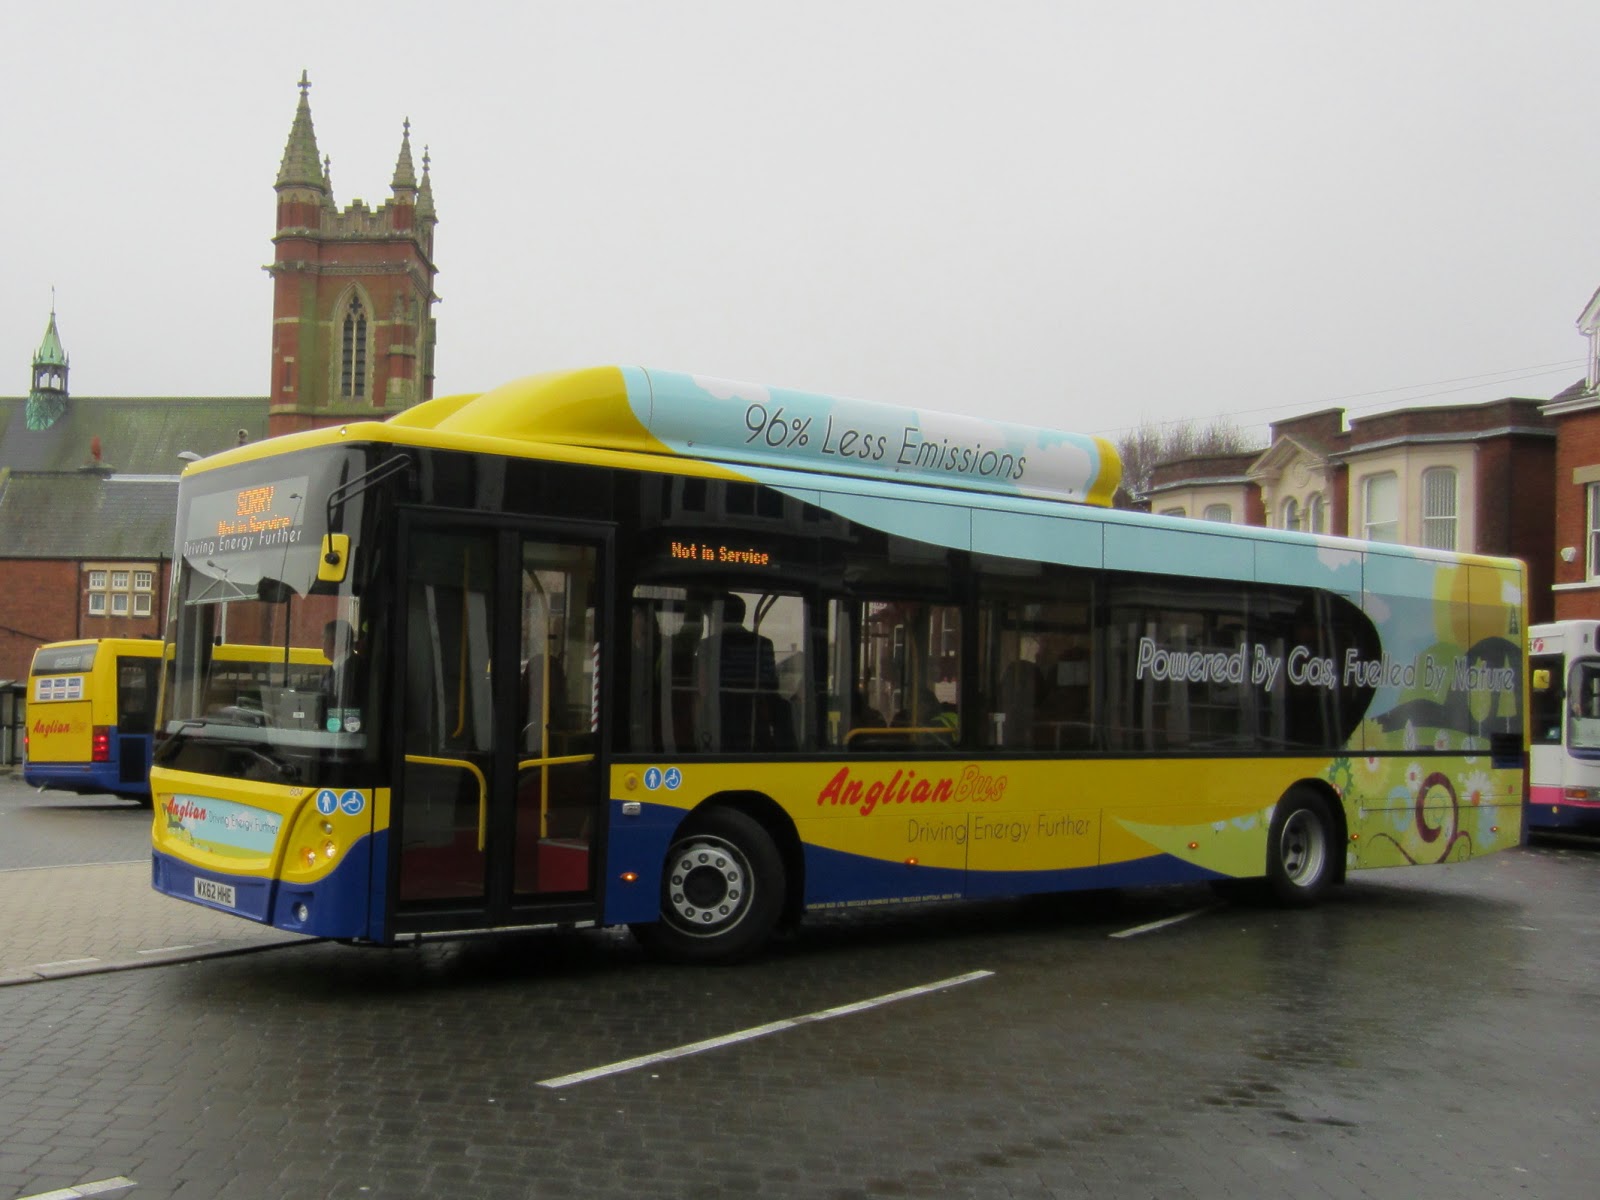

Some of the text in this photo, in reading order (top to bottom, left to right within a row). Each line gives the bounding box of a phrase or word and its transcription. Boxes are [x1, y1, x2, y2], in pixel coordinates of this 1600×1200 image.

[745, 403, 1027, 480] 96% Less Emissions
[236, 486, 275, 516] SORRY
[217, 514, 290, 535] Not in Service
[183, 527, 302, 557] Driving Energy Further
[671, 542, 769, 565] Not in Service
[1137, 637, 1516, 696] Powered By Gas, Fuelled By Nature
[33, 718, 70, 738] Anglian
[167, 796, 207, 822] Anglian
[908, 813, 1091, 845] Driving Energy Further
[196, 880, 232, 904] WX62 HHE
